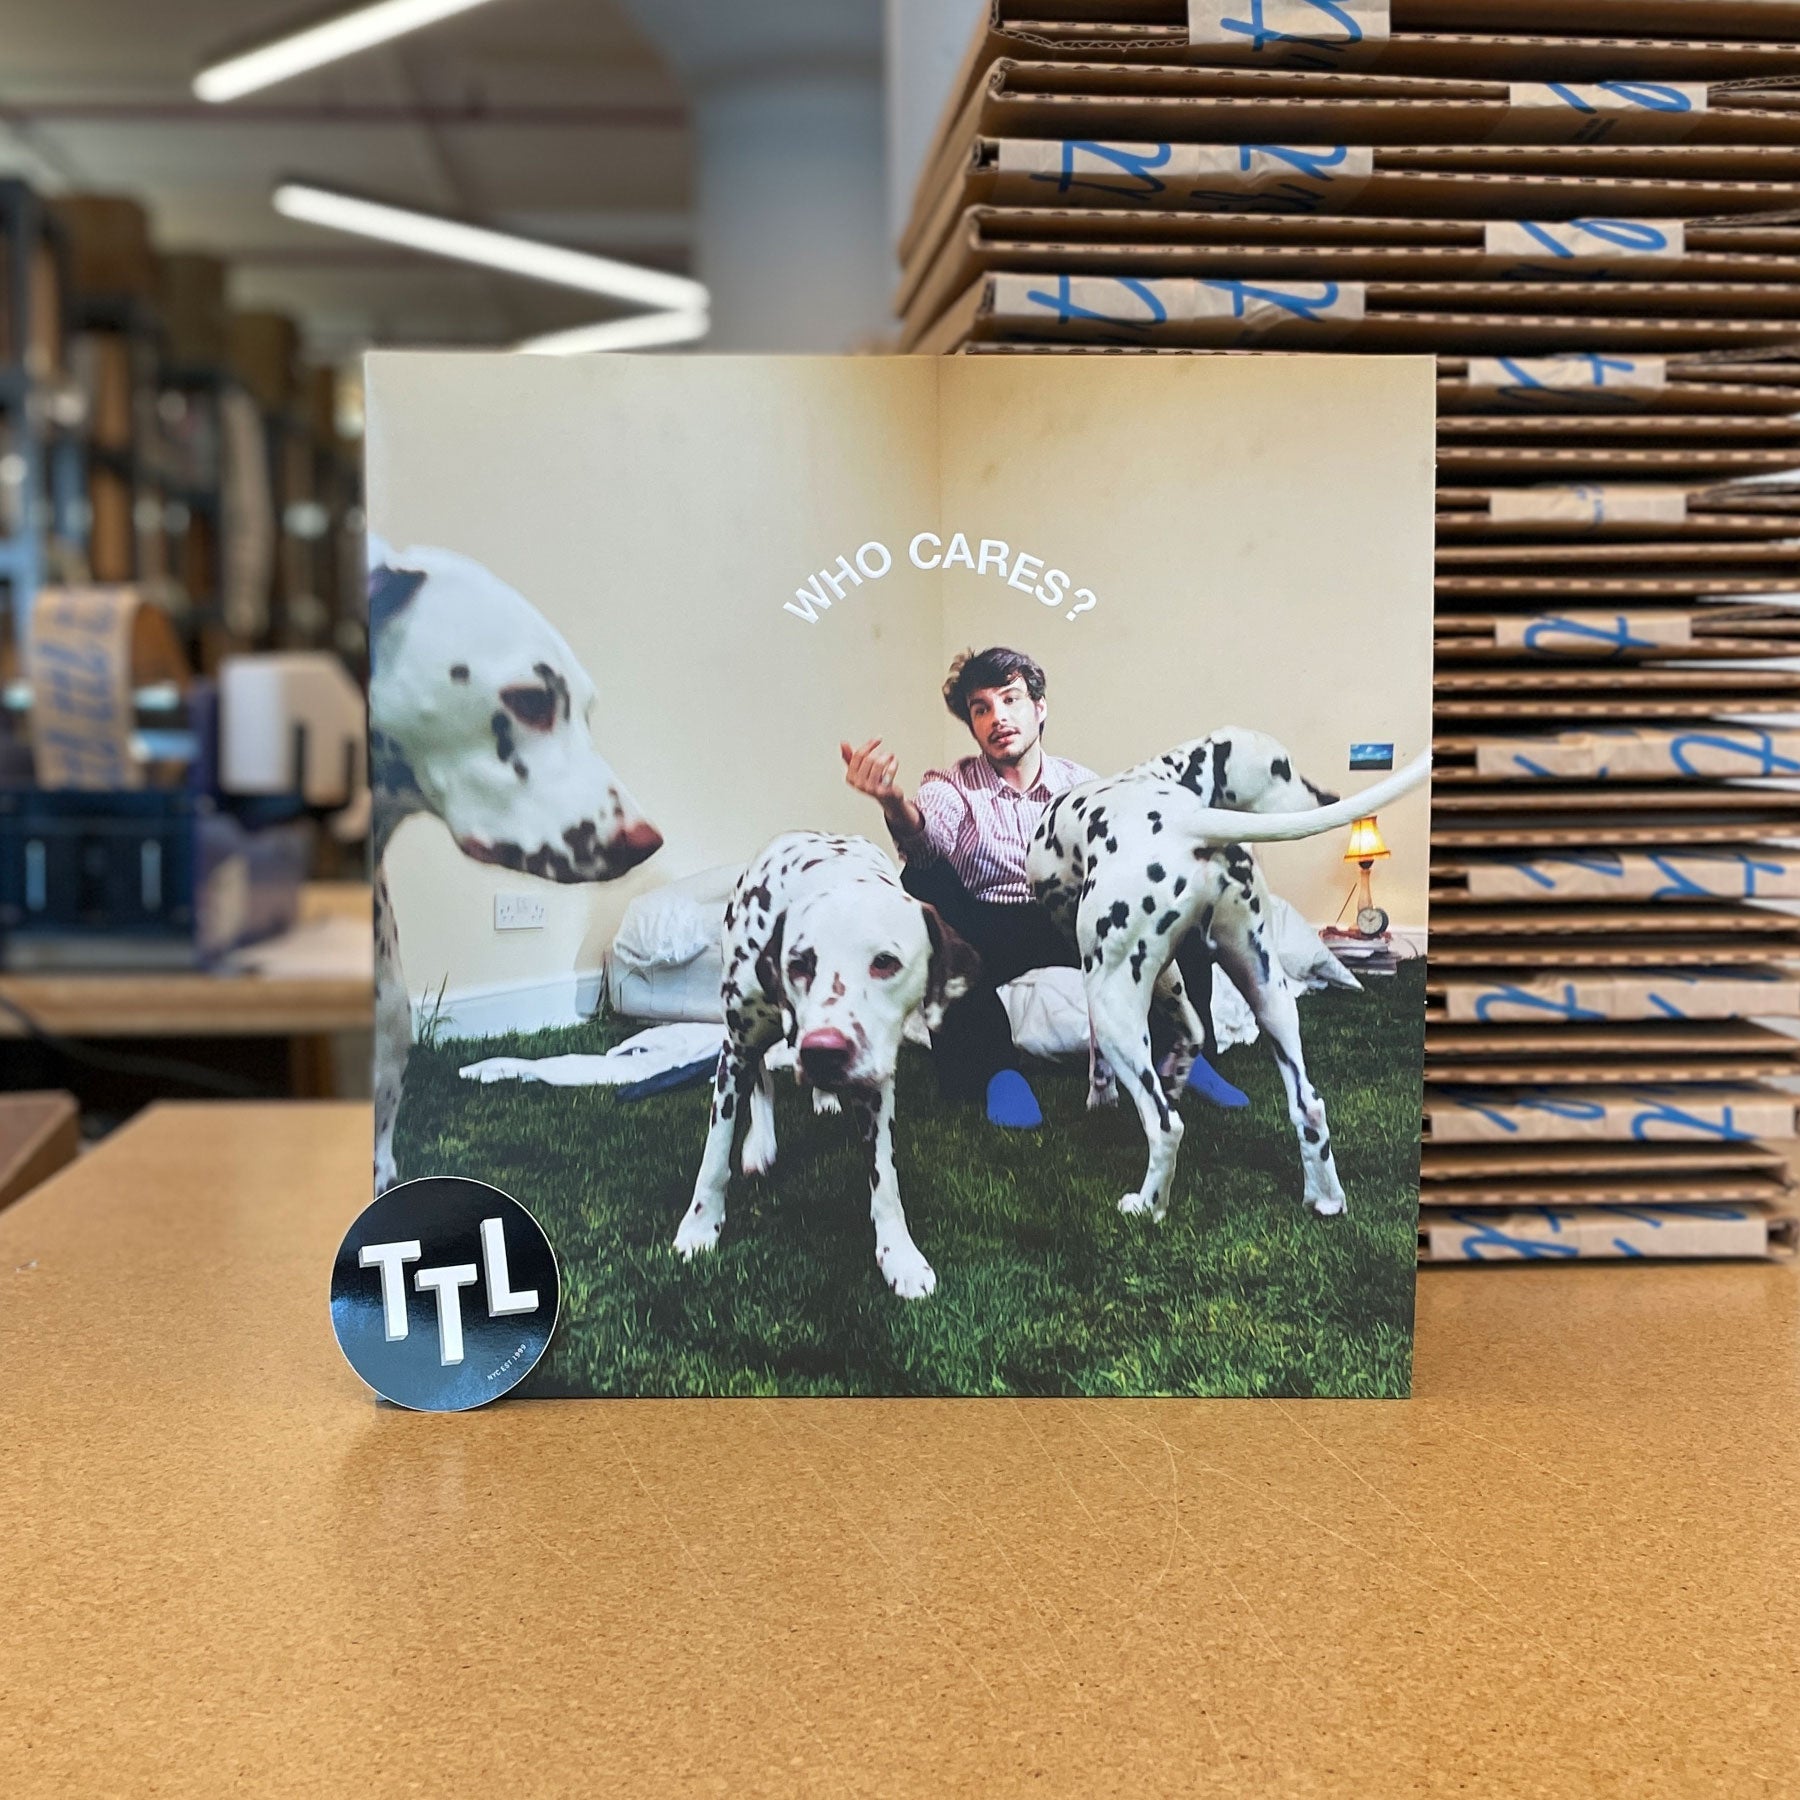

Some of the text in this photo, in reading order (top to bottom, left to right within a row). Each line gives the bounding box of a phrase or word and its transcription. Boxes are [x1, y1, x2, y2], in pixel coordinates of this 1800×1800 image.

[783, 532, 1097, 624] WHO CARES?
[358, 1217, 540, 1367] TTL
[487, 1343, 527, 1381] NYC EST 1999
